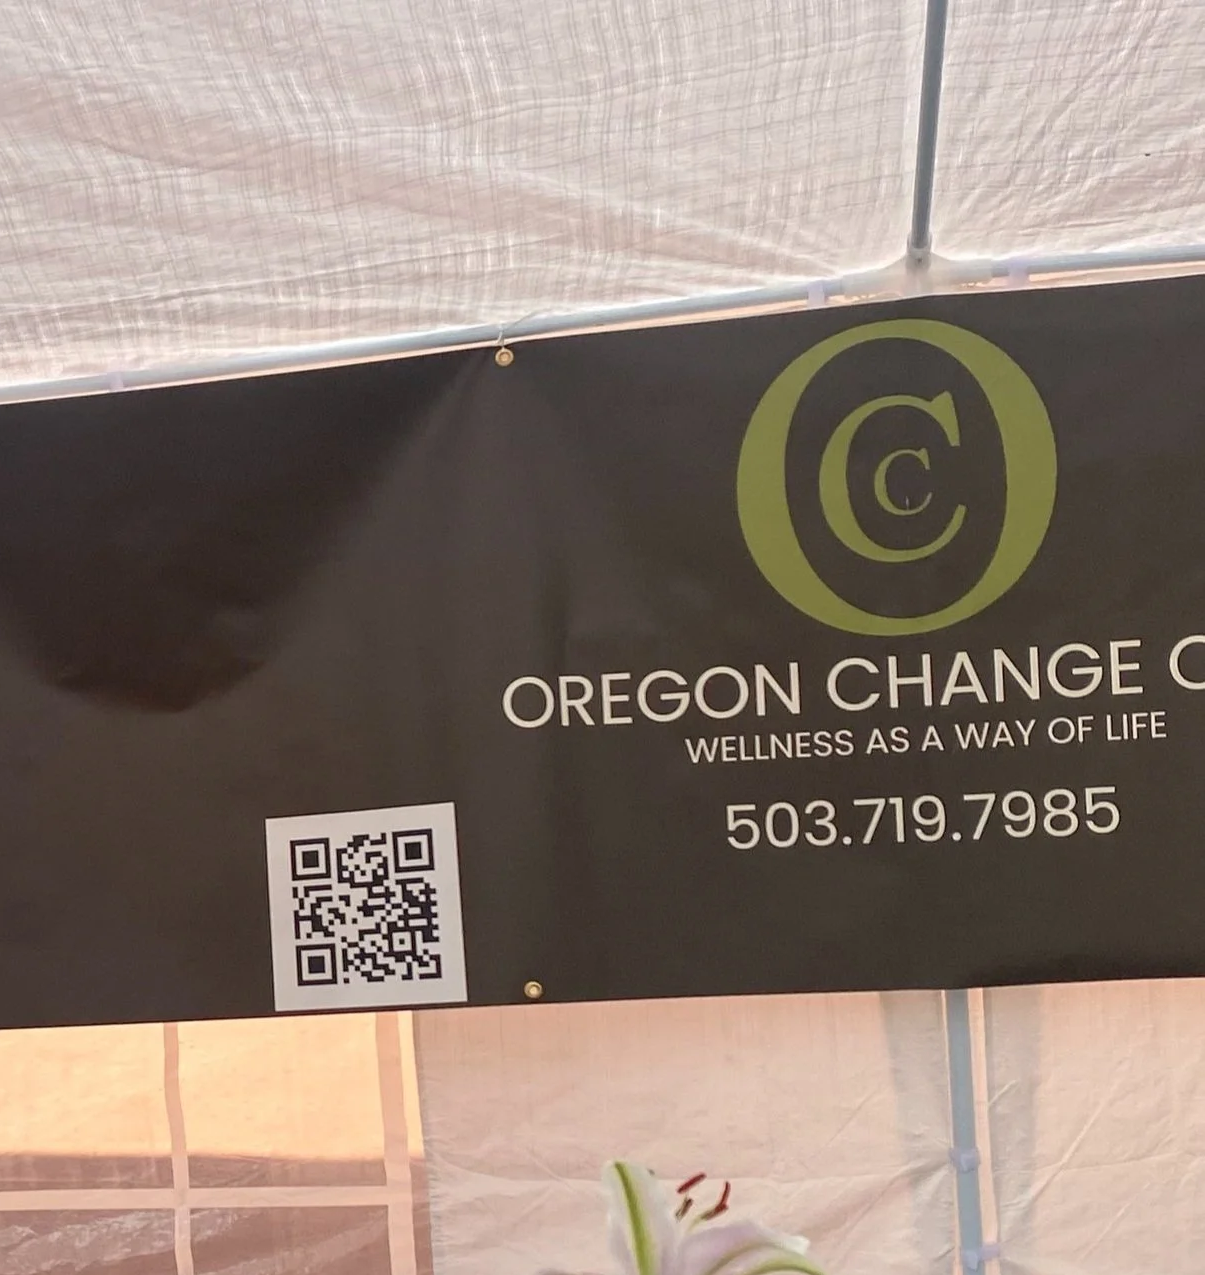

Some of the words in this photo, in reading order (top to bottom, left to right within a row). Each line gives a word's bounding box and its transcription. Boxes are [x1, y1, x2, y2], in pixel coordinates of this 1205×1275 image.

[502, 661, 801, 728] OREGON
[826, 639, 1143, 712] CHANGE
[685, 727, 855, 764] WELLNESS
[866, 725, 910, 755] AS
[921, 724, 945, 753] A
[954, 718, 1037, 751] WAY
[1047, 715, 1094, 744] OF
[1106, 711, 1167, 741] LIFE
[725, 786, 1121, 850] 503.719.7985
